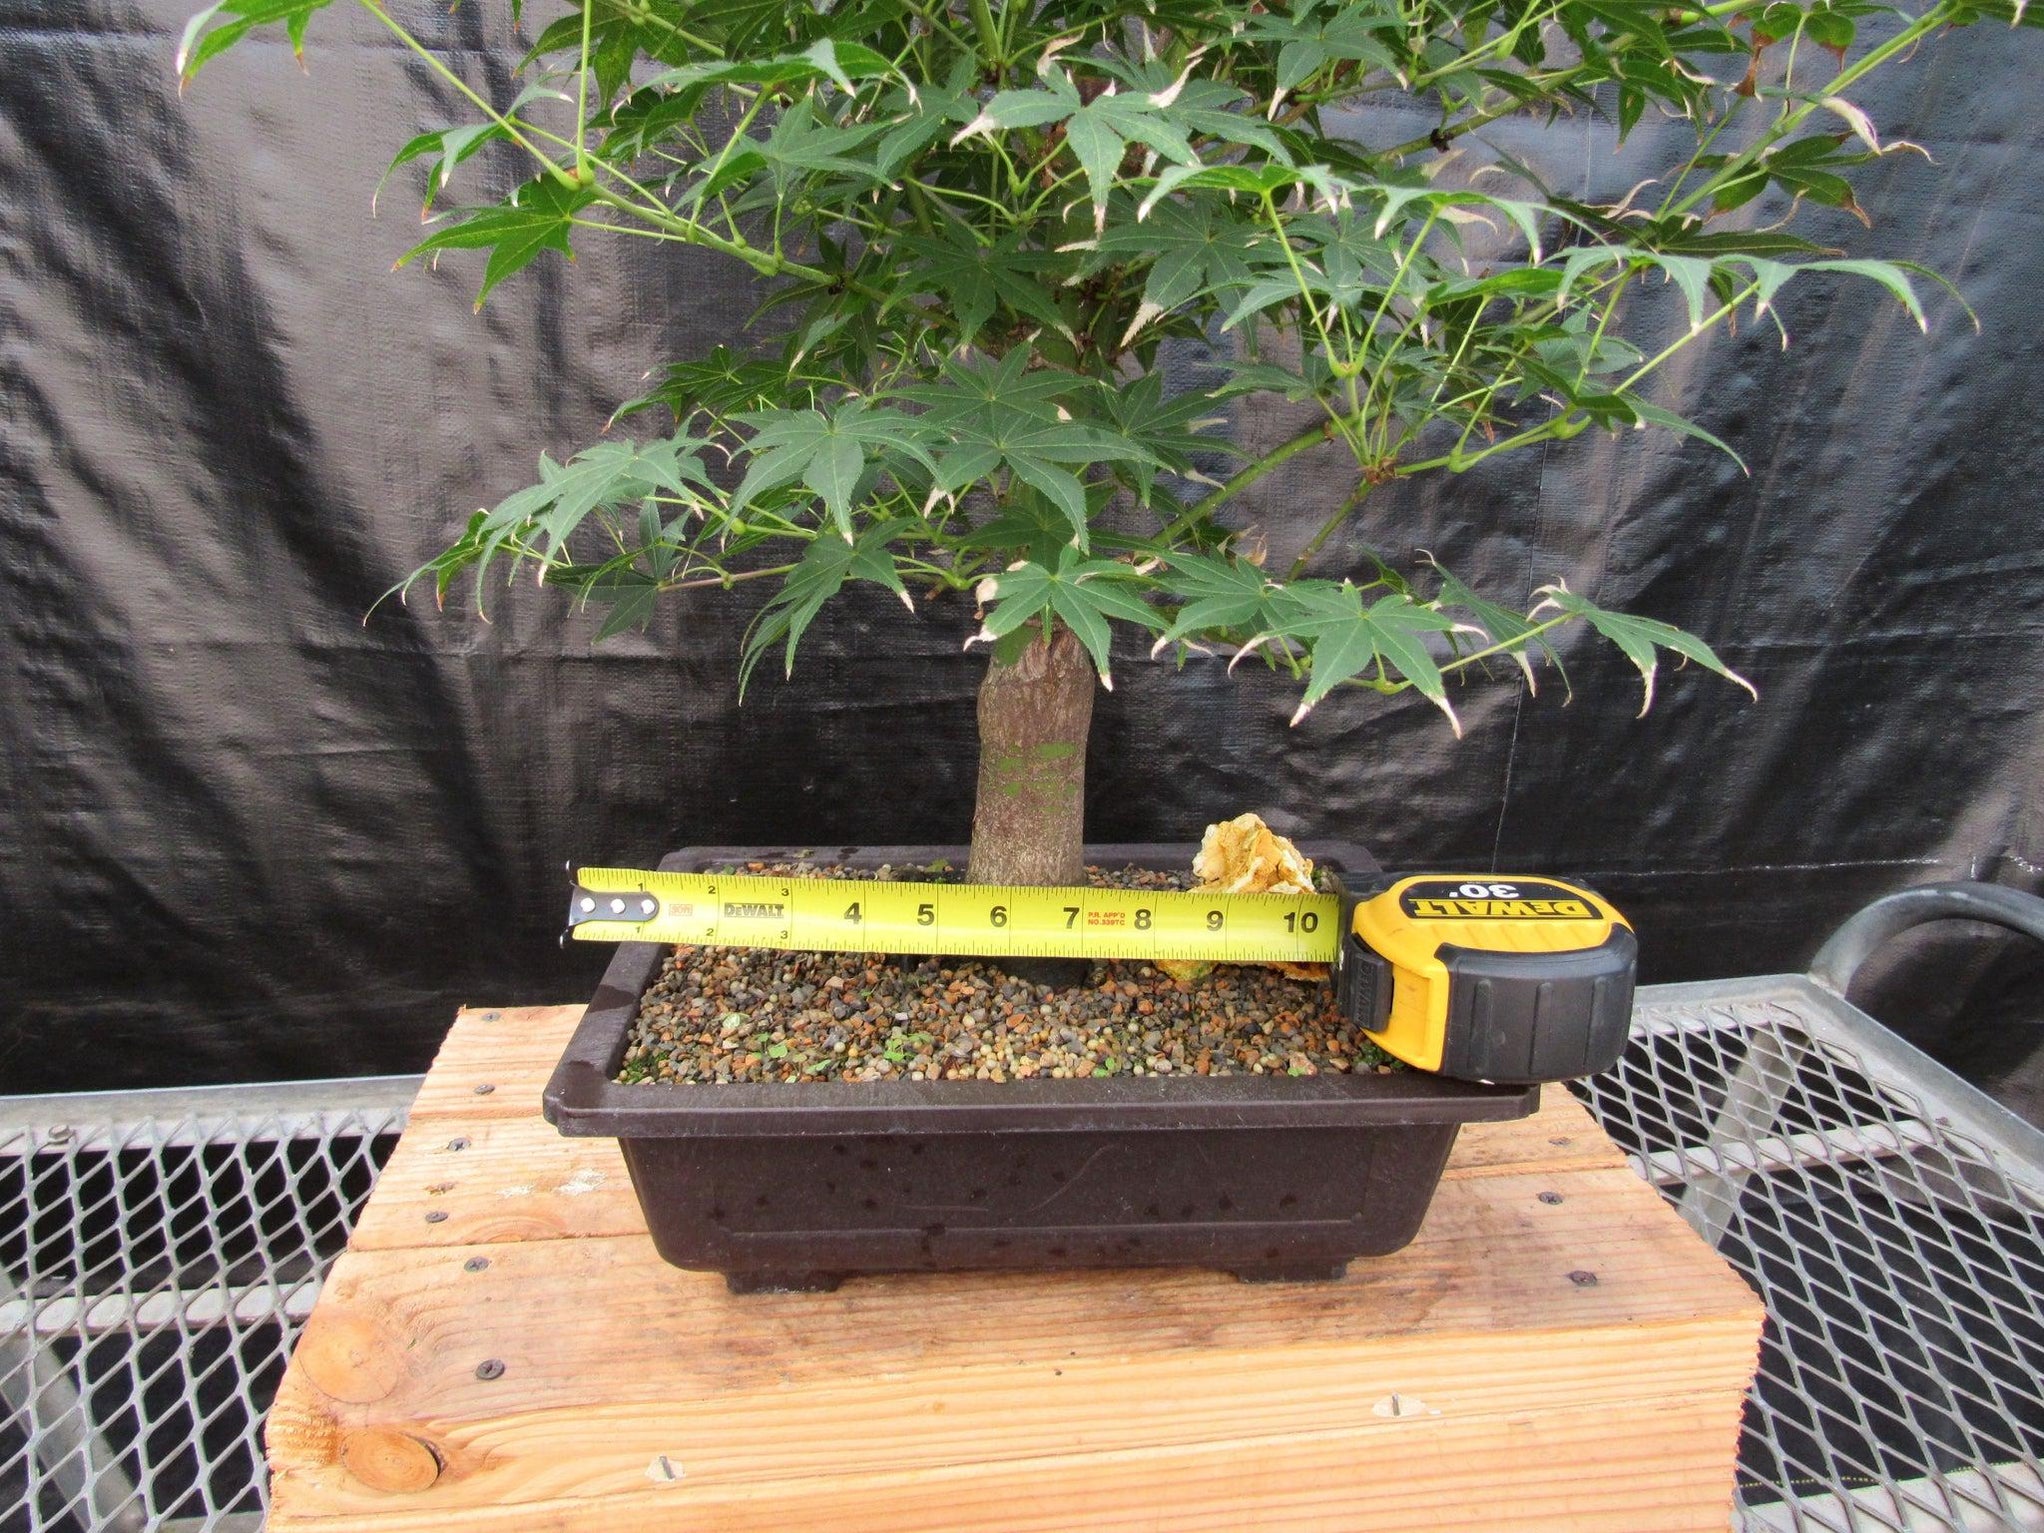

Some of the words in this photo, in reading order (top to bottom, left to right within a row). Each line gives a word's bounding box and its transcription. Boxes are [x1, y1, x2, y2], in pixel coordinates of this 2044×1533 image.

[708, 886, 716, 894] 2
[781, 888, 789, 896] 3
[844, 902, 862, 924] 4
[917, 904, 934, 925] 5
[990, 906, 1007, 927] 6
[1063, 907, 1080, 929] 7
[1134, 908, 1152, 931] 8
[1206, 910, 1224, 931] 9
[1283, 911, 1319, 933] 10
[706, 928, 714, 936] 2
[780, 930, 788, 939] 3
